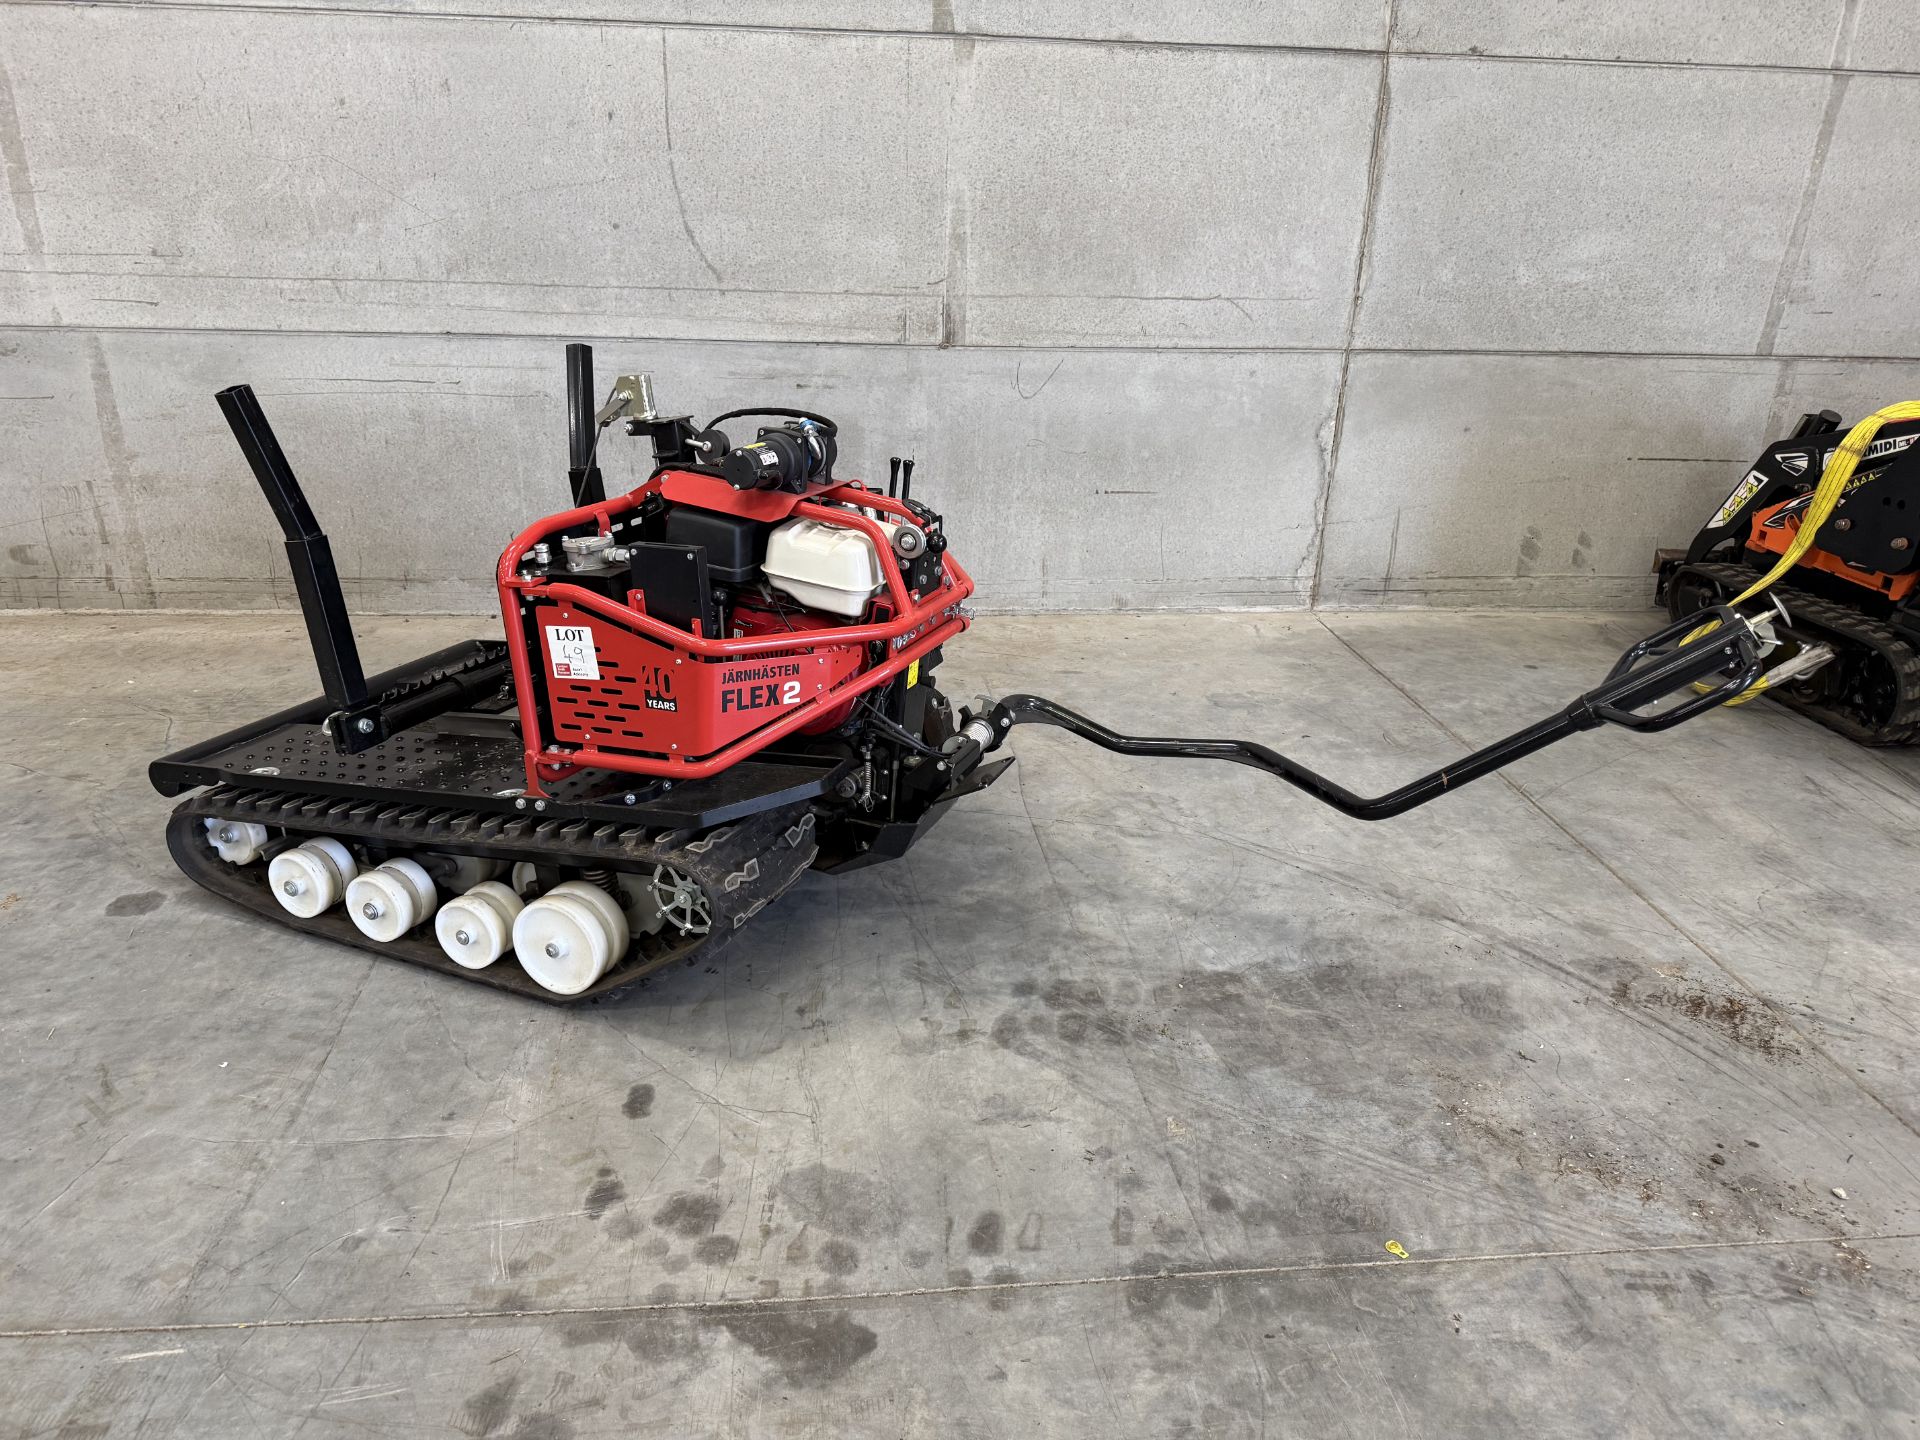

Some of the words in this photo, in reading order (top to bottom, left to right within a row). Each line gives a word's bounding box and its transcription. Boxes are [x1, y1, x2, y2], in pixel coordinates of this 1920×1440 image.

[1864, 439, 1897, 458] MIDI
[555, 629, 584, 642] LOT
[562, 644, 585, 664] 49
[642, 664, 677, 699] 40
[721, 663, 800, 685] JÄRNHÄSTEN
[646, 698, 676, 711] YEARS
